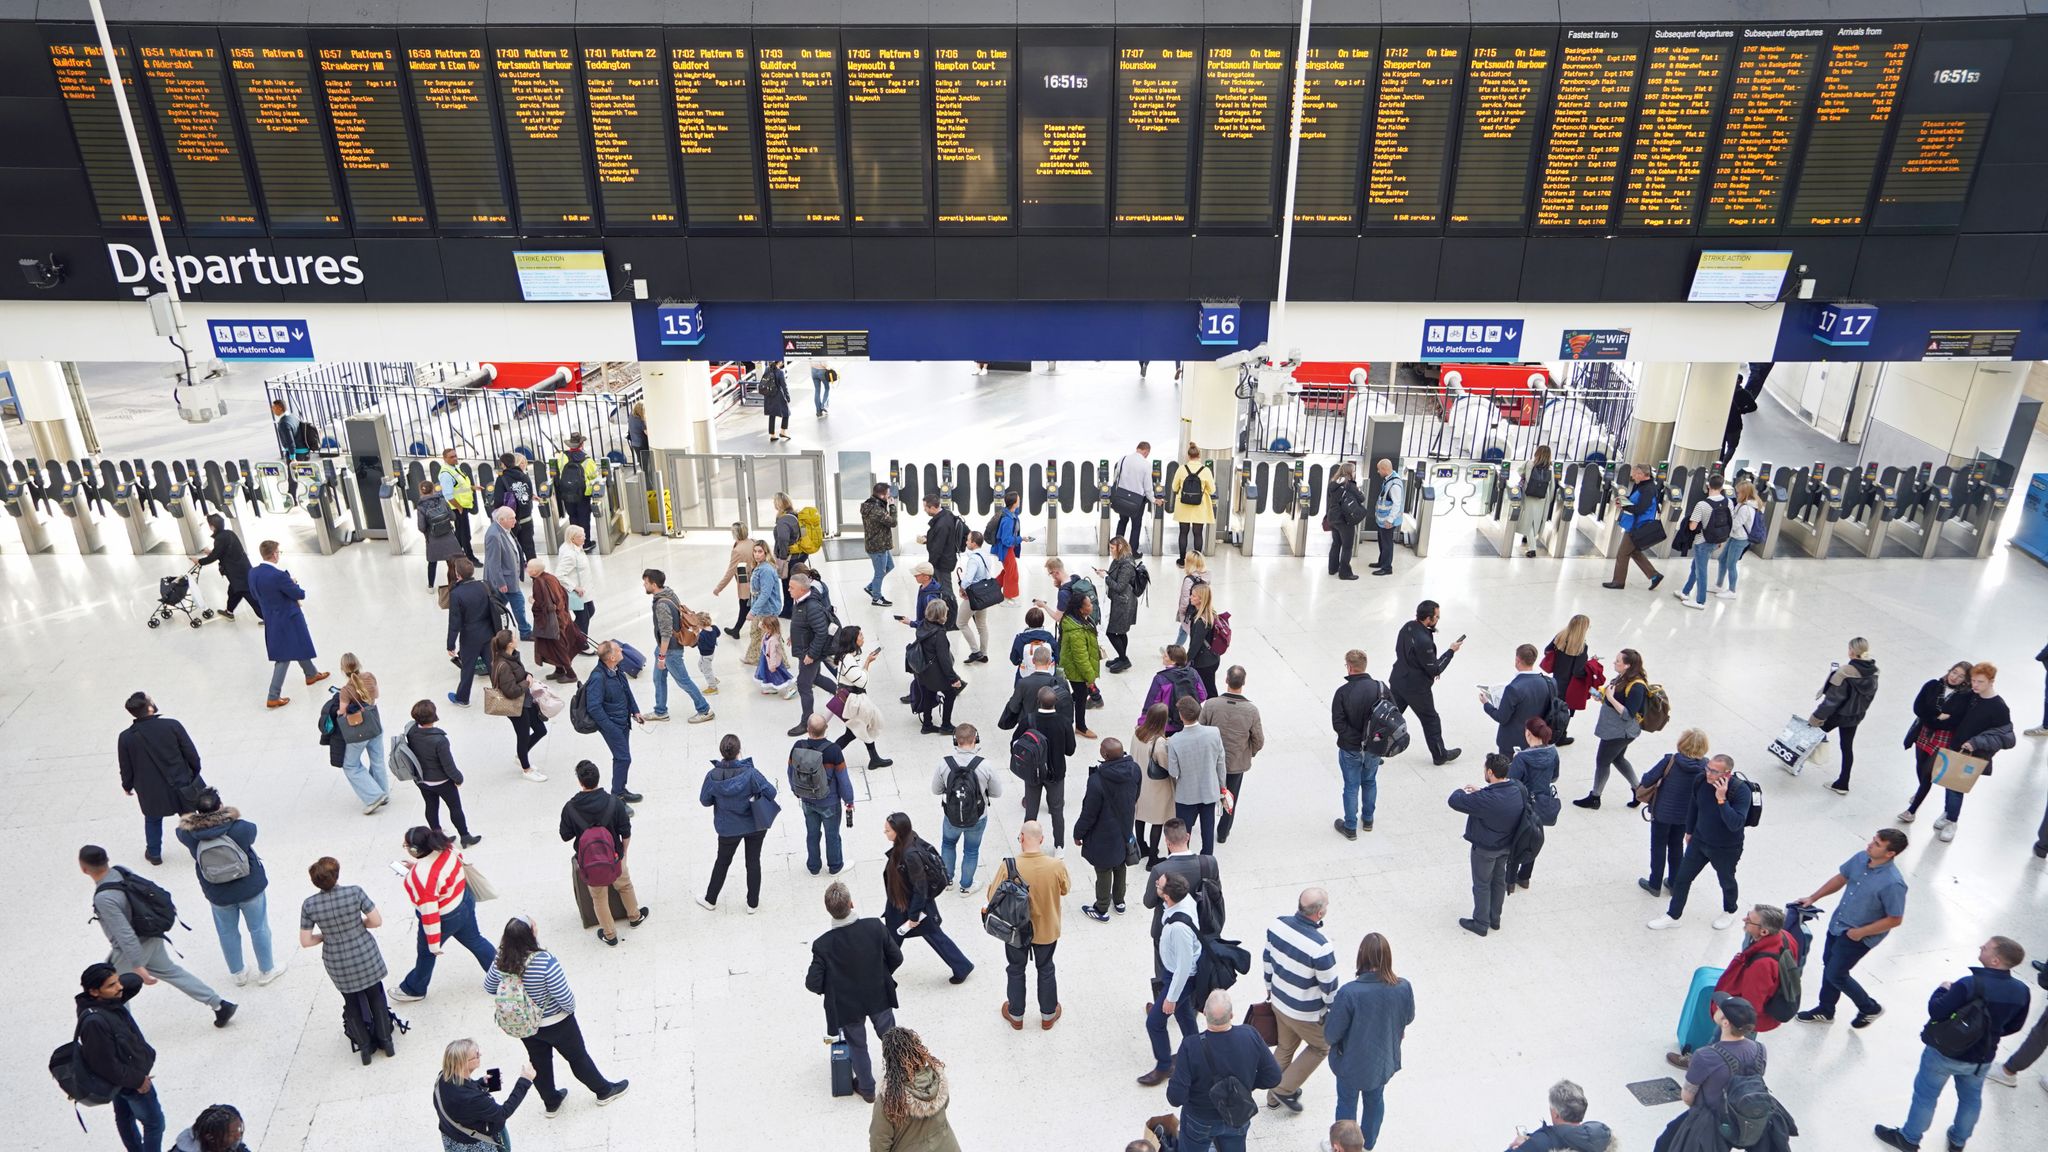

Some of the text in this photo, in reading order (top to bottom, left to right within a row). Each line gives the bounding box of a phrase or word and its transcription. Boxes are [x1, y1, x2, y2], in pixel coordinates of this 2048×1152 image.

[1568, 31, 1594, 39] Fastest
[1611, 31, 1619, 39] to
[1655, 30, 1734, 40] Subsequent departures
[1744, 27, 1823, 38] Subsequent departures
[1838, 27, 1882, 35] Arrivals from
[50, 46, 126, 56] 16:54 1
[140, 47, 214, 58] 16:54 Platform 17
[231, 48, 254, 58] 16:55
[263, 49, 295, 58] Platform
[319, 49, 392, 59] 16:57 Platform 5
[408, 49, 481, 59] 16:58 Platform 20
[496, 49, 569, 58] 17:00 Platform 12
[585, 49, 656, 58] 17:01 Platform 22
[672, 49, 744, 59] 17:02 Platform 15
[760, 49, 832, 58] 17:03 On time
[879, 49, 910, 58] Platform
[914, 49, 919, 58] 9
[935, 49, 1007, 58] 17:06 On time
[1121, 49, 1193, 58] 17:07 On time
[1209, 49, 1280, 58] 17:09 On time
[1338, 49, 1349, 58] On
[1352, 49, 1369, 58] time
[1385, 49, 1457, 58] 17:12 On time
[1474, 49, 1546, 58] 17:15 On time
[53, 58, 92, 68] Guildford
[144, 60, 193, 69] & Aldershot
[233, 60, 255, 70] Alton
[321, 61, 384, 72] Strawberry Hill
[409, 61, 437, 70] Windsor
[440, 61, 446, 70] &
[448, 61, 466, 70] Eton
[497, 61, 573, 71] Portsmouth Harbour
[586, 60, 630, 70] Teddington
[673, 60, 709, 70] Guildford
[760, 60, 796, 70] Guildford
[848, 61, 895, 71] Weymouth &
[935, 61, 995, 71] Hampton Court
[1120, 61, 1156, 70] Hounslow
[1207, 61, 1283, 70] Portsmouth Harbour
[1384, 60, 1431, 70] Shepperton
[1471, 60, 1548, 70] Portsmouth Harbour
[664, 315, 692, 335] 15
[1208, 315, 1235, 334] 16
[1819, 311, 1837, 332] 17
[1840, 315, 1872, 335] 17
[1606, 335, 1628, 343] WiFi
